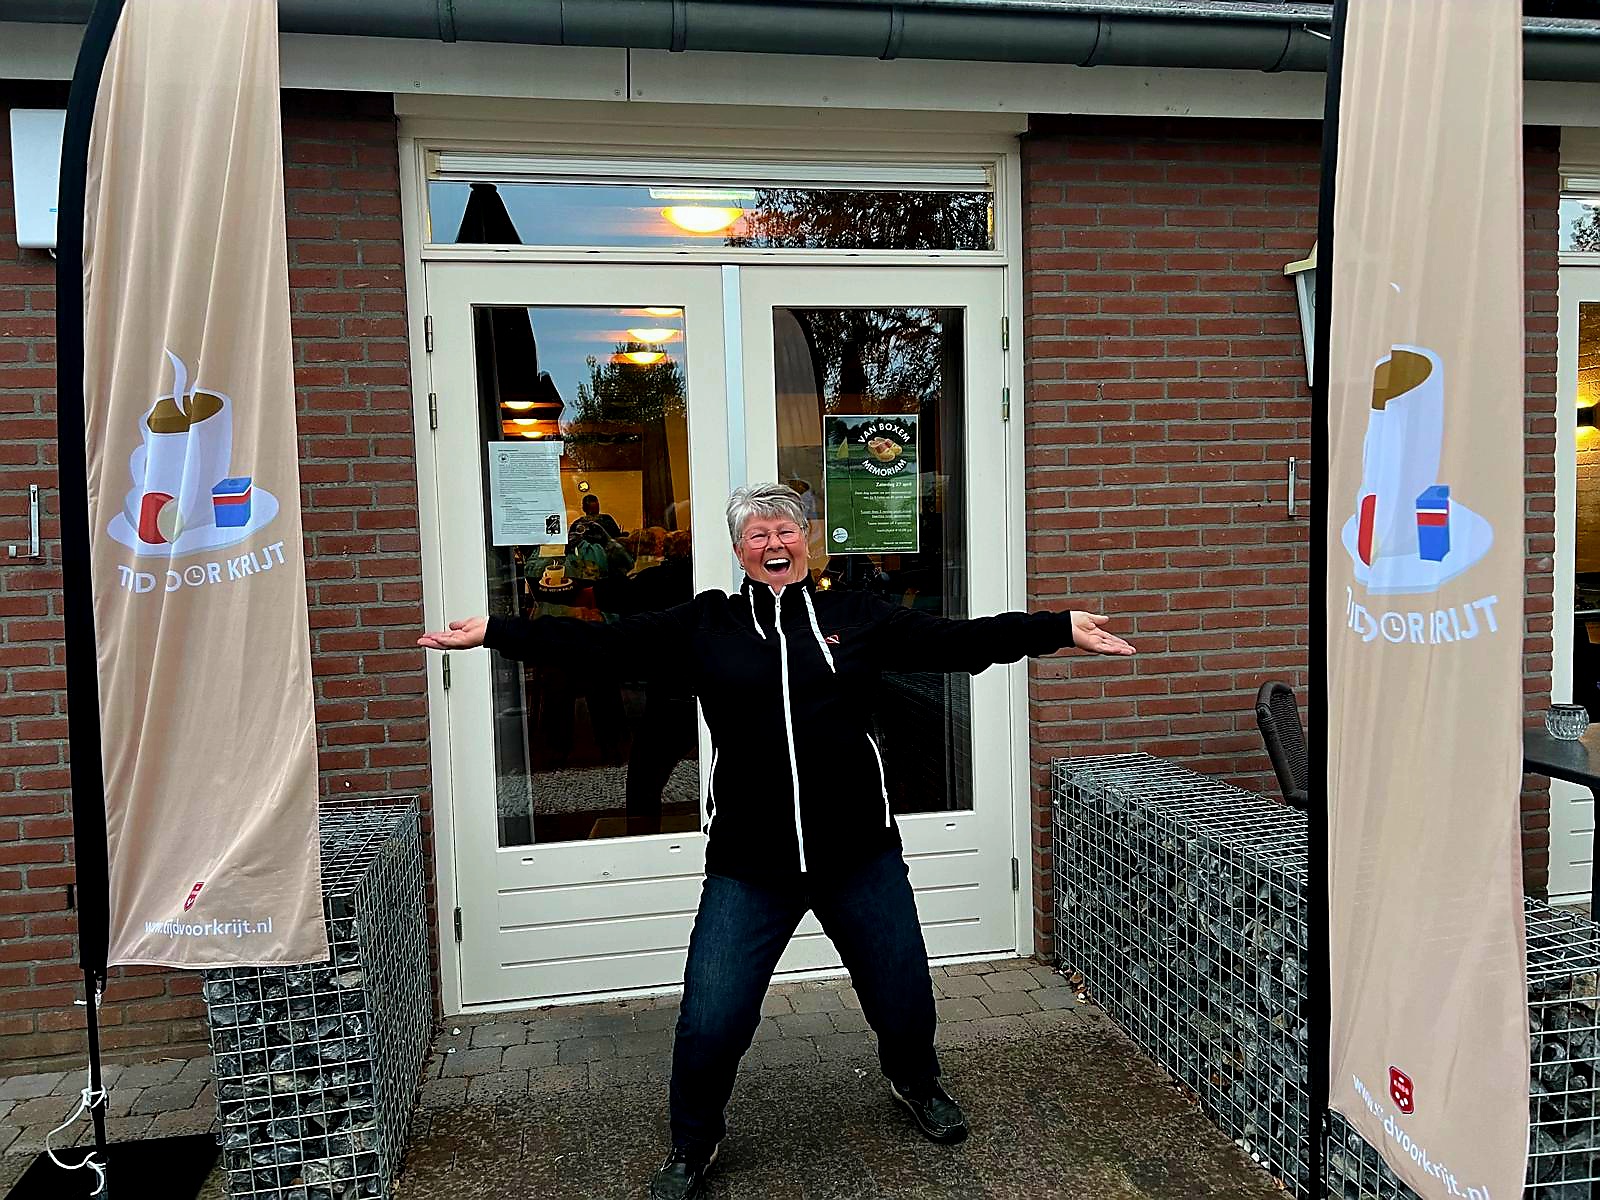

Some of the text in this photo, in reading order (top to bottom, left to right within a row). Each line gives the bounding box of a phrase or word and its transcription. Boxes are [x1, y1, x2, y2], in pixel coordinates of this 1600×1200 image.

[858, 423, 910, 443] VAN BOXEM
[862, 459, 907, 477] MEMORIAM
[227, 541, 286, 581] KRIJT
